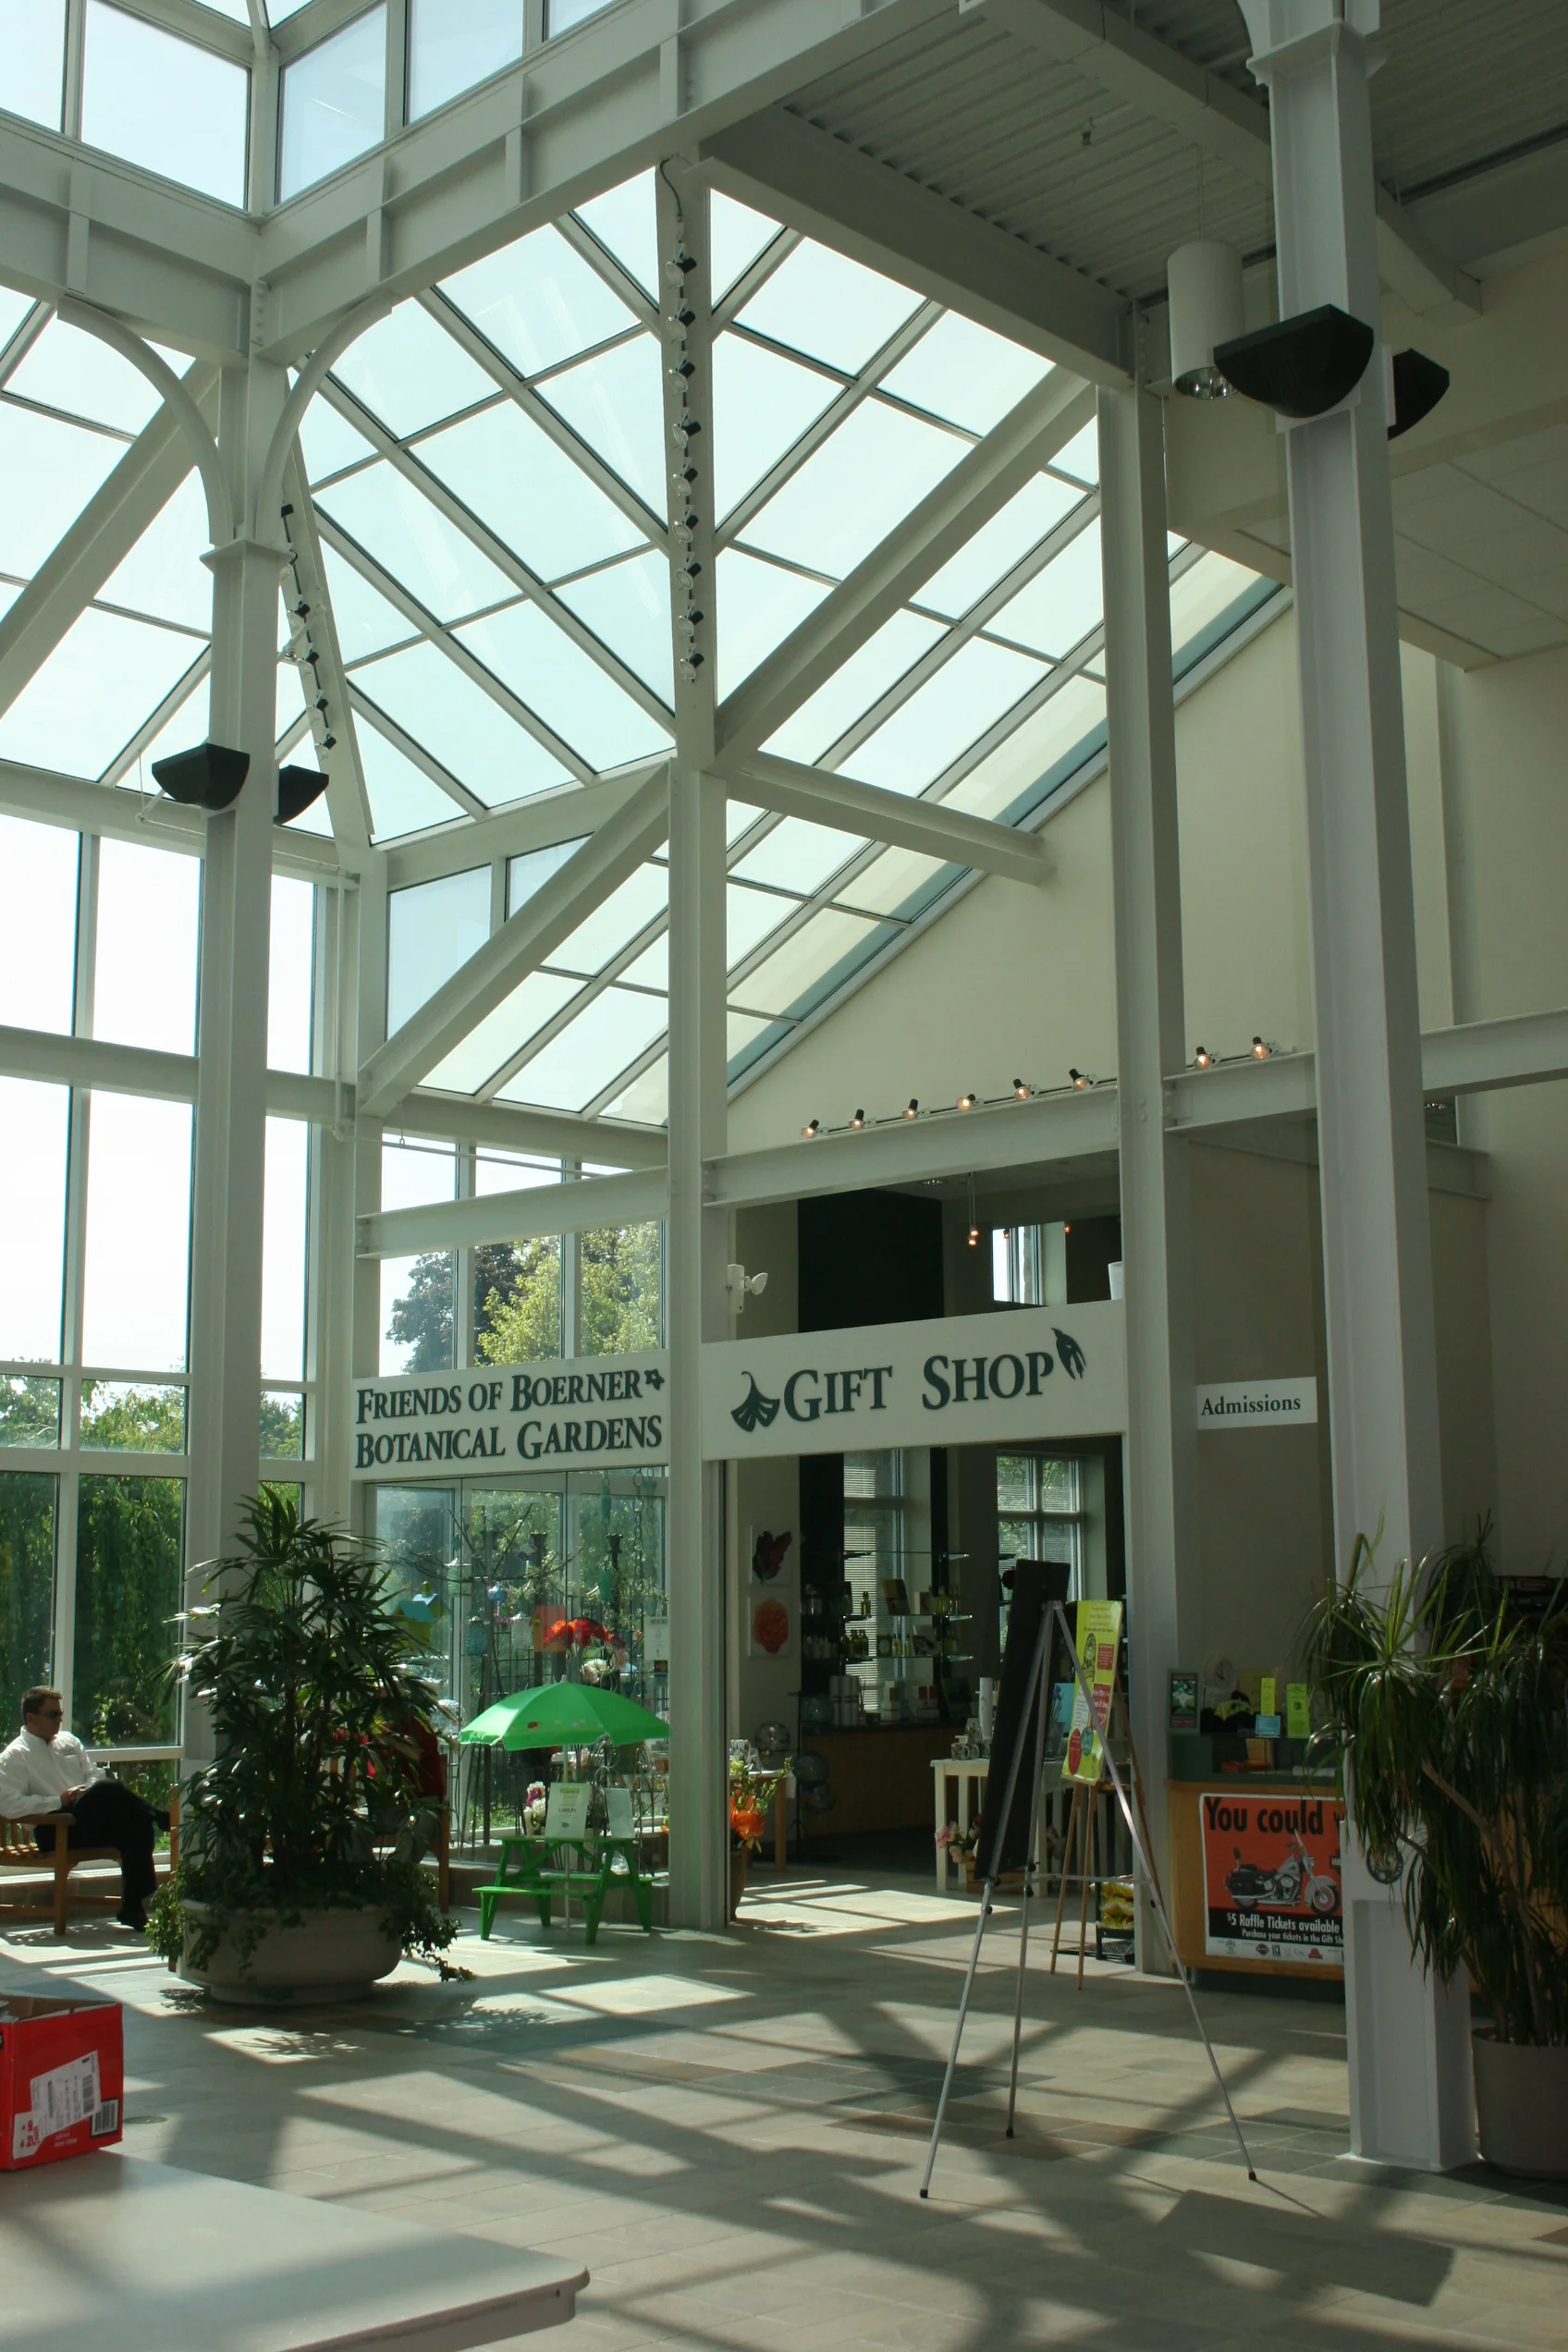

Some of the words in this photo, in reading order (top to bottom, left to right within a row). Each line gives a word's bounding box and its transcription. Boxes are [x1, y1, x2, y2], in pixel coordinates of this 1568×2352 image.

[356, 1385, 461, 1424] FRIENDS
[468, 1381, 503, 1412] OF
[509, 1369, 643, 1412] BOERNER
[783, 1366, 893, 1422] GIFT
[922, 1352, 1054, 1411] SHOP
[1200, 1394, 1301, 1415] Admissions
[355, 1427, 506, 1468] BOTANICAL
[517, 1415, 662, 1460] GARDENS
[1204, 1796, 1247, 1832] You
[1257, 1799, 1323, 1835] could
[1227, 1912, 1237, 1926] $5
[1239, 1914, 1265, 1929] Raffle
[1267, 1916, 1296, 1930] Tickets
[1298, 1918, 1340, 1933] available
[1242, 1929, 1267, 1939] Purchase
[1268, 1931, 1281, 1941] your
[1282, 1931, 1302, 1942] tickets
[1303, 1933, 1309, 1942] in
[1310, 1933, 1320, 1942] the
[1321, 1933, 1333, 1943] Gift
